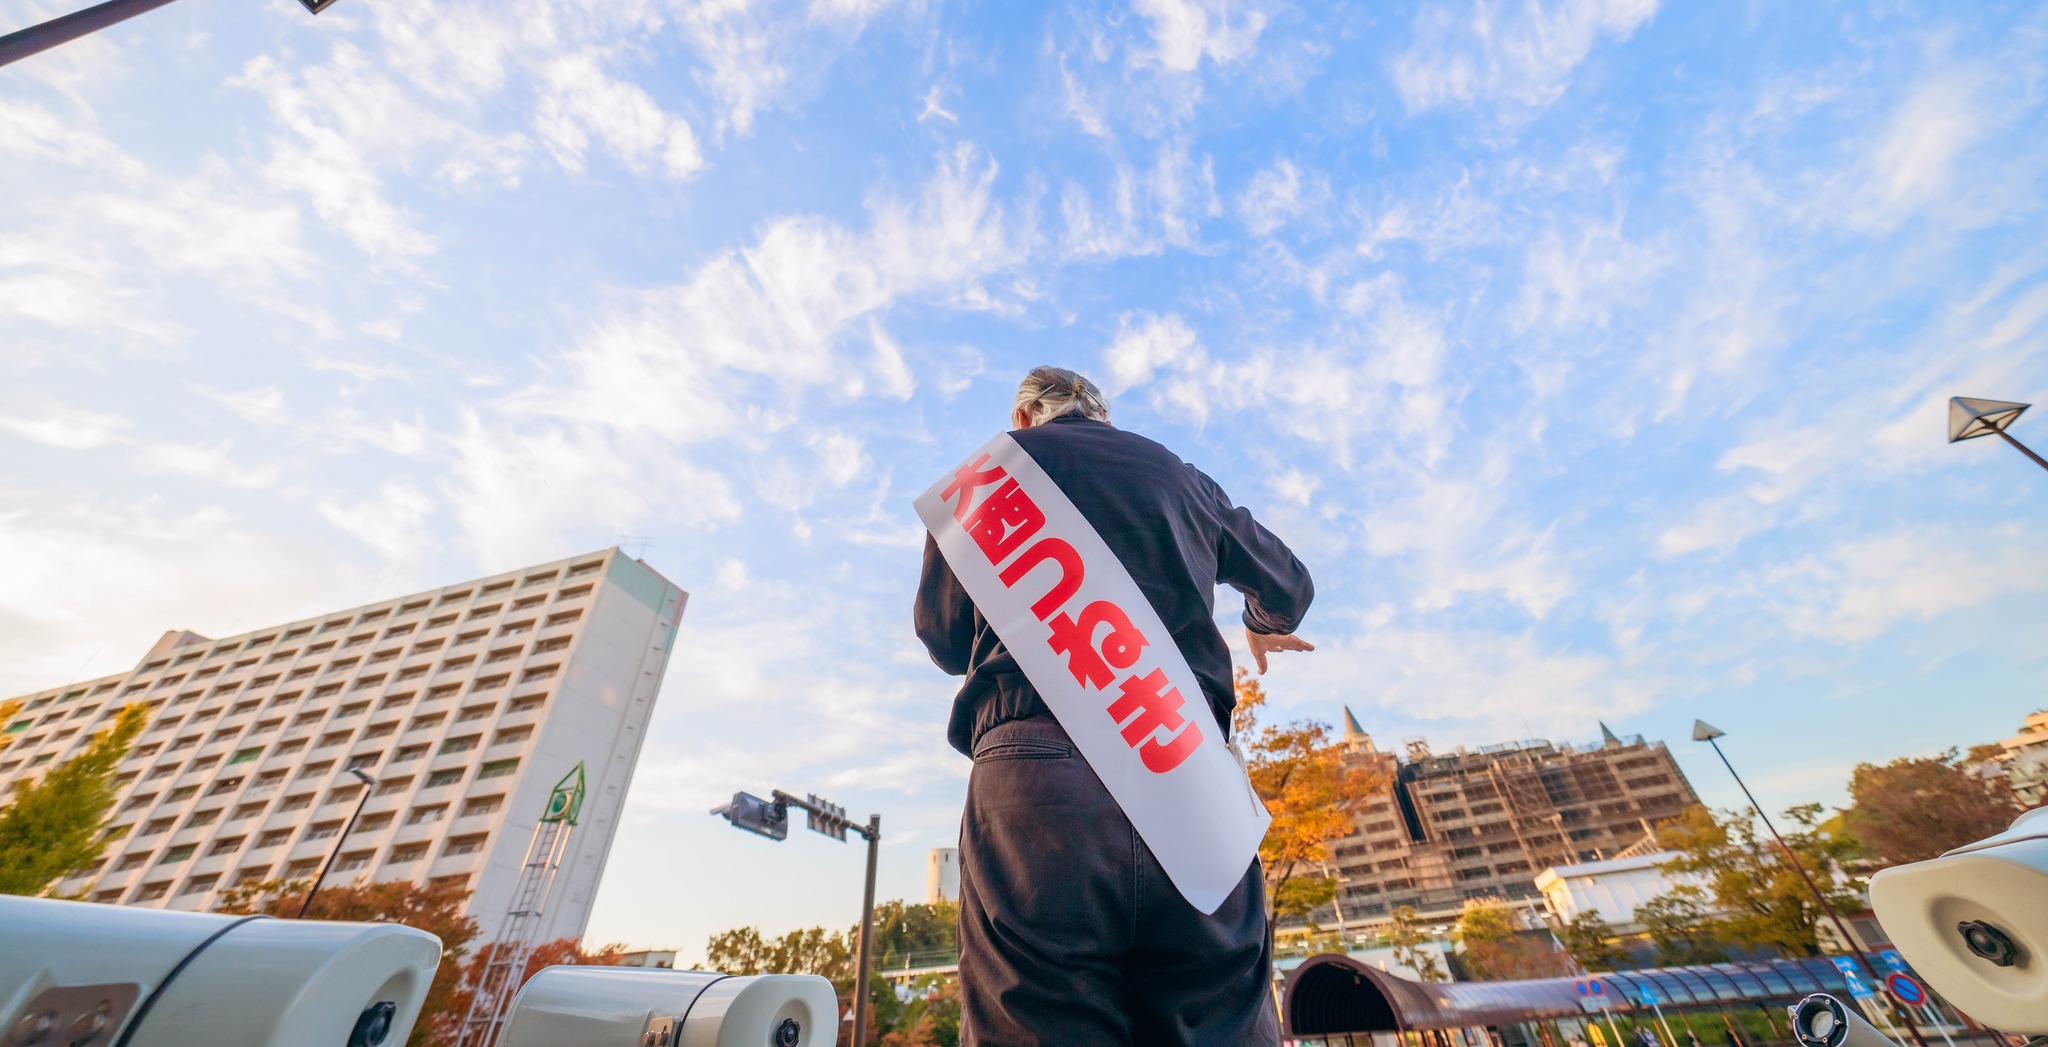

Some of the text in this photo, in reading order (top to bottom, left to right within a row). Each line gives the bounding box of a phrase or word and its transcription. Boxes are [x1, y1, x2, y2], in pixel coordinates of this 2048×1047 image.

[940, 453, 1204, 774] 大西つねき
